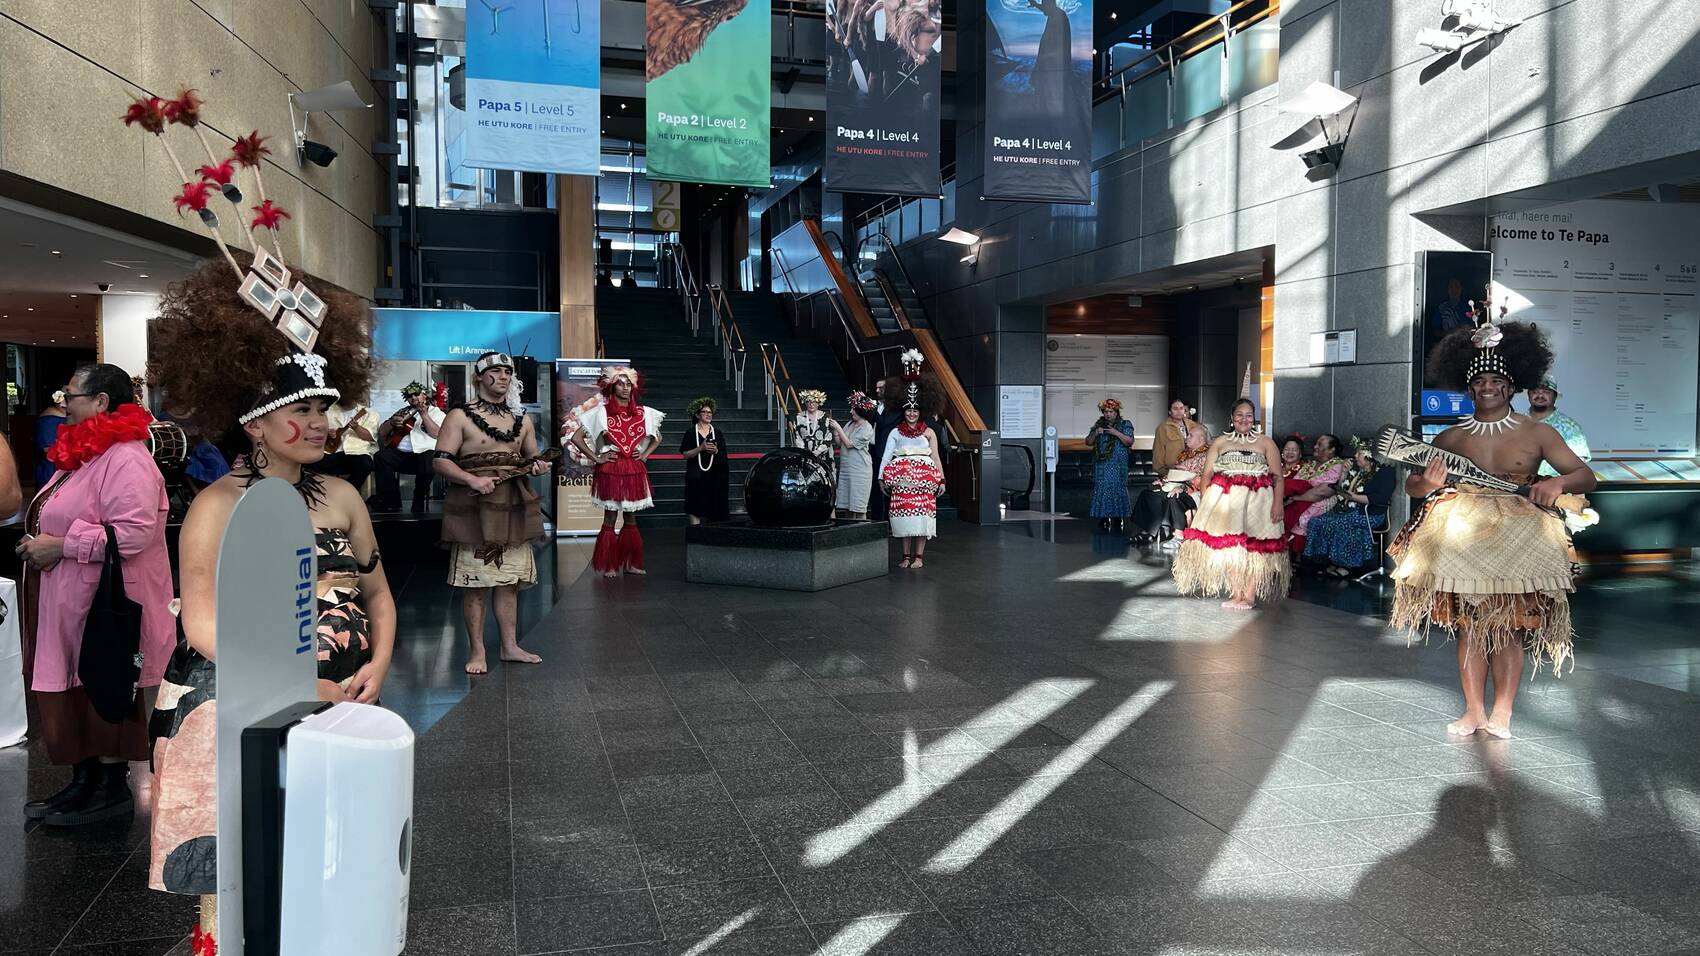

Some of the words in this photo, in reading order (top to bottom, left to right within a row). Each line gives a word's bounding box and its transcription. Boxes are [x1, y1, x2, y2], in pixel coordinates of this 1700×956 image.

[478, 98, 511, 112] Papa
[514, 102, 522, 112] 5
[531, 103, 563, 115] Level
[567, 105, 575, 116] 5
[491, 120, 509, 128] UTU
[510, 122, 533, 130] KORE
[539, 124, 559, 132] FREE
[560, 126, 588, 134] ENTRY
[657, 112, 689, 126] Papa
[691, 114, 699, 126] 2
[707, 115, 737, 128] Level
[739, 118, 747, 129] 2
[687, 135, 709, 143] KORE
[714, 136, 731, 145] FREE
[734, 138, 759, 146] ENTRY
[837, 126, 865, 140] Papa
[866, 128, 875, 140] 4
[882, 129, 910, 142] Level
[911, 132, 920, 143] 4
[993, 136, 1021, 149] Papa
[1022, 138, 1030, 148] 4
[1037, 138, 1063, 151] Level
[1064, 140, 1072, 151] 4
[836, 145, 846, 153] HE
[847, 146, 862, 154] UTU
[863, 148, 883, 156] KORE
[887, 149, 904, 157] FREE
[658, 183, 675, 206] 2
[1522, 211, 1549, 223] haere
[1552, 212, 1573, 223] mai!
[1490, 225, 1538, 240] elcome
[1541, 228, 1555, 241] to
[1559, 229, 1574, 242] Te
[1577, 230, 1610, 246] Papa
[1504, 258, 1508, 266] 1
[1563, 260, 1569, 269] 2
[1609, 262, 1615, 271] 3
[558, 474, 593, 487] Pacif
[296, 547, 312, 655] Initial
